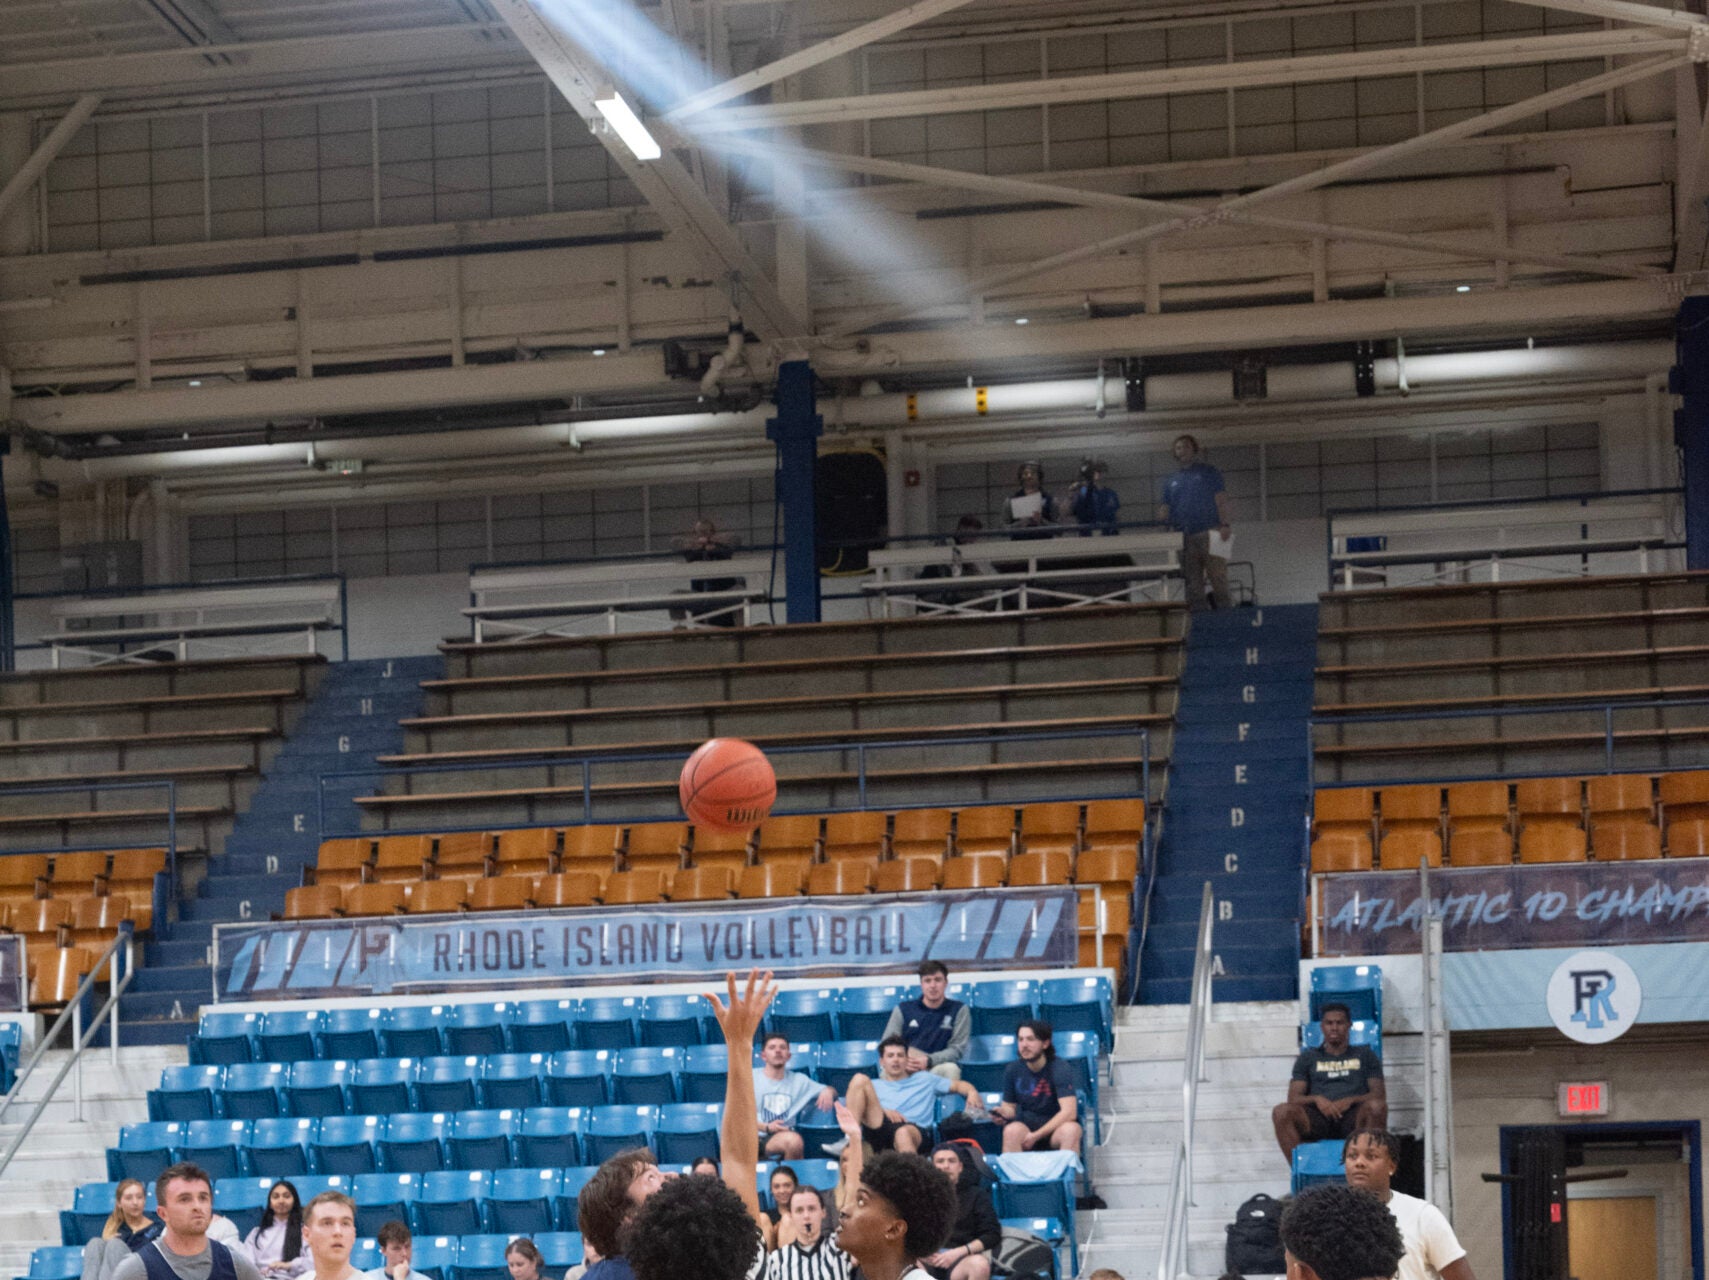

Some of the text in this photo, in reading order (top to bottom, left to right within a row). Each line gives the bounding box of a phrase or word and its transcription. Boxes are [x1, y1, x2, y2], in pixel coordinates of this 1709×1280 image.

[1251, 610, 1263, 627] J
[1246, 647, 1259, 665] H
[382, 661, 394, 679] J
[1243, 685, 1256, 703] G
[361, 699, 372, 715] H
[1238, 723, 1250, 741] F
[338, 736, 349, 753] G
[1235, 765, 1247, 783] E
[294, 815, 305, 832] E
[1231, 807, 1245, 827] D
[267, 855, 278, 874] D
[1224, 853, 1239, 873] C
[240, 901, 251, 919] C
[1219, 900, 1233, 921] B
[433, 911, 911, 973] RHODE ISLAND VOLLEYBALL
[1211, 954, 1226, 976] A
[170, 999, 183, 1019] A
[1567, 1084, 1601, 1112] EXIT
